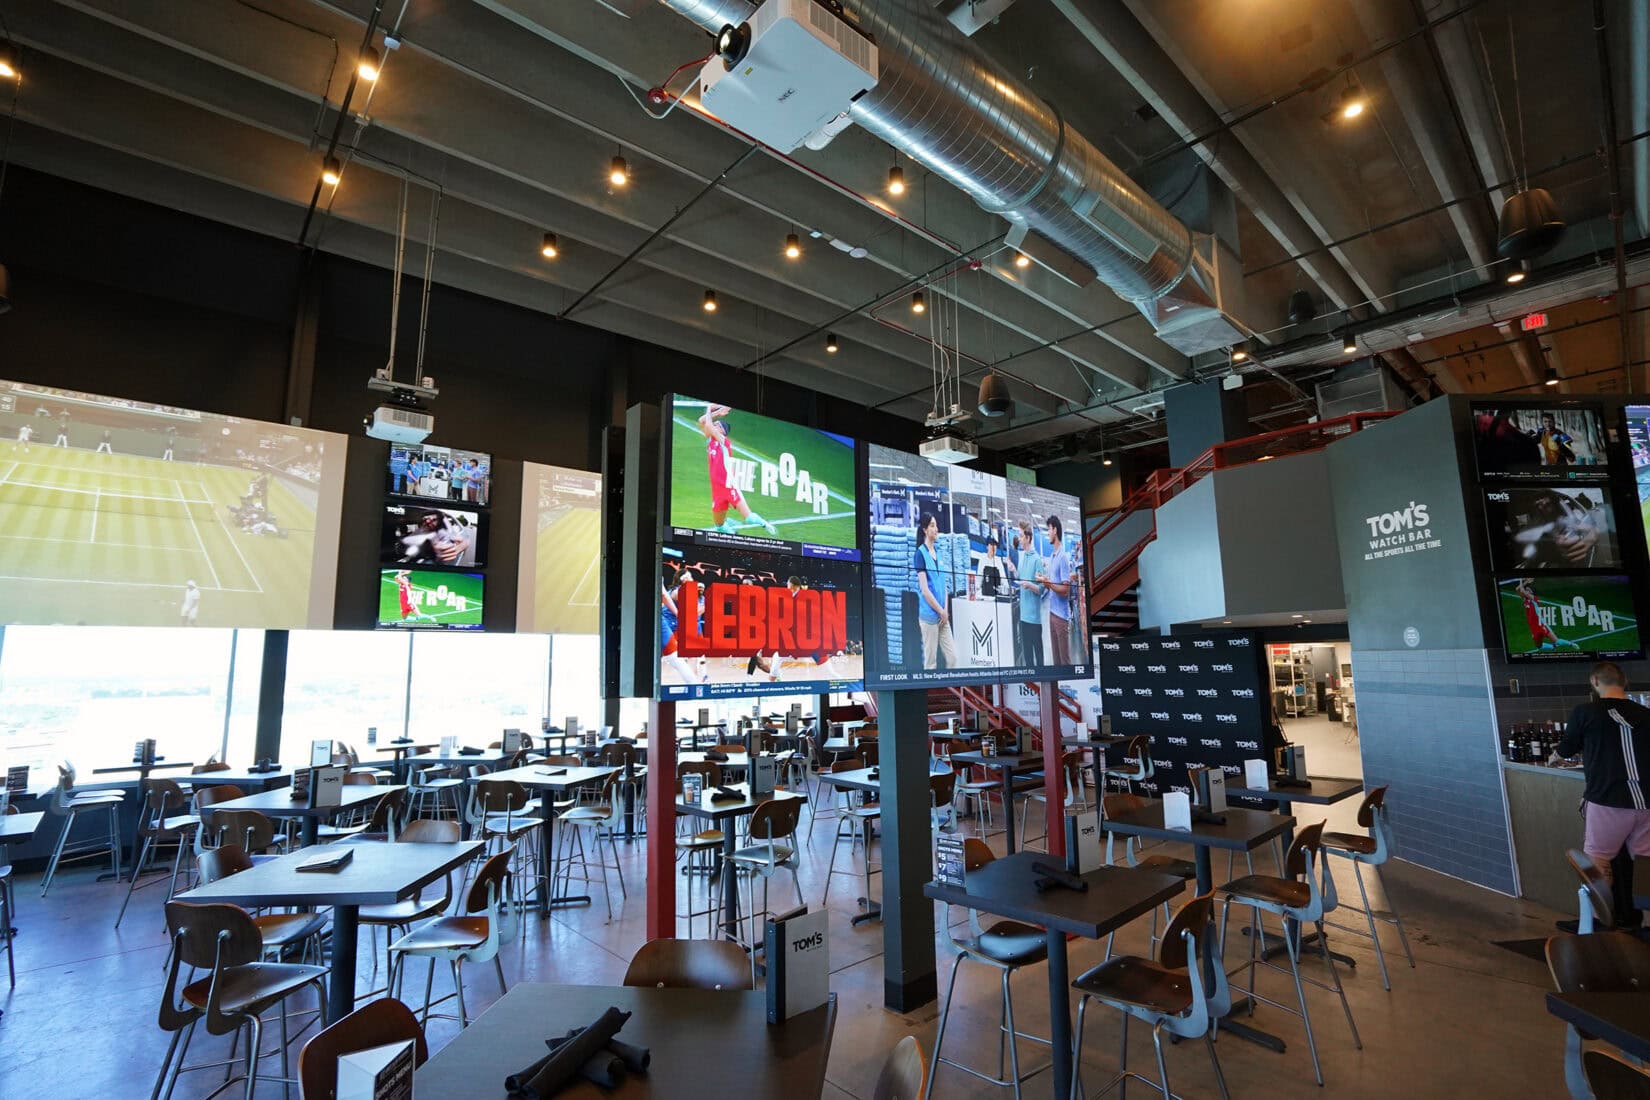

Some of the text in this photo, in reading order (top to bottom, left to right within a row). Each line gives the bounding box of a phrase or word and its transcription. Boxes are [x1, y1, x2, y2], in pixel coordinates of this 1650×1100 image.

[726, 452, 828, 514] THE ROAR
[1488, 492, 1510, 500] TOM'S
[1366, 501, 1430, 537] TOM'S
[1370, 528, 1432, 550] WATCH BAR
[1384, 547, 1404, 557] SPORTS
[1415, 543, 1426, 551] THE
[1427, 540, 1442, 548] TIME
[426, 585, 466, 611] ROAR
[1538, 596, 1614, 631] THE ROAR
[678, 580, 847, 657] LEBRON
[1193, 640, 1214, 648] TOM'S
[1228, 638, 1249, 646] TOM'S
[1179, 664, 1198, 672] TOM'S
[1212, 664, 1233, 672] TOM'S
[1232, 688, 1254, 697] TOM'S
[1216, 714, 1237, 722] TOM'S
[1200, 738, 1221, 746] TOM'S
[1236, 740, 1257, 749] TOM'S
[793, 932, 823, 952] TOM'S
